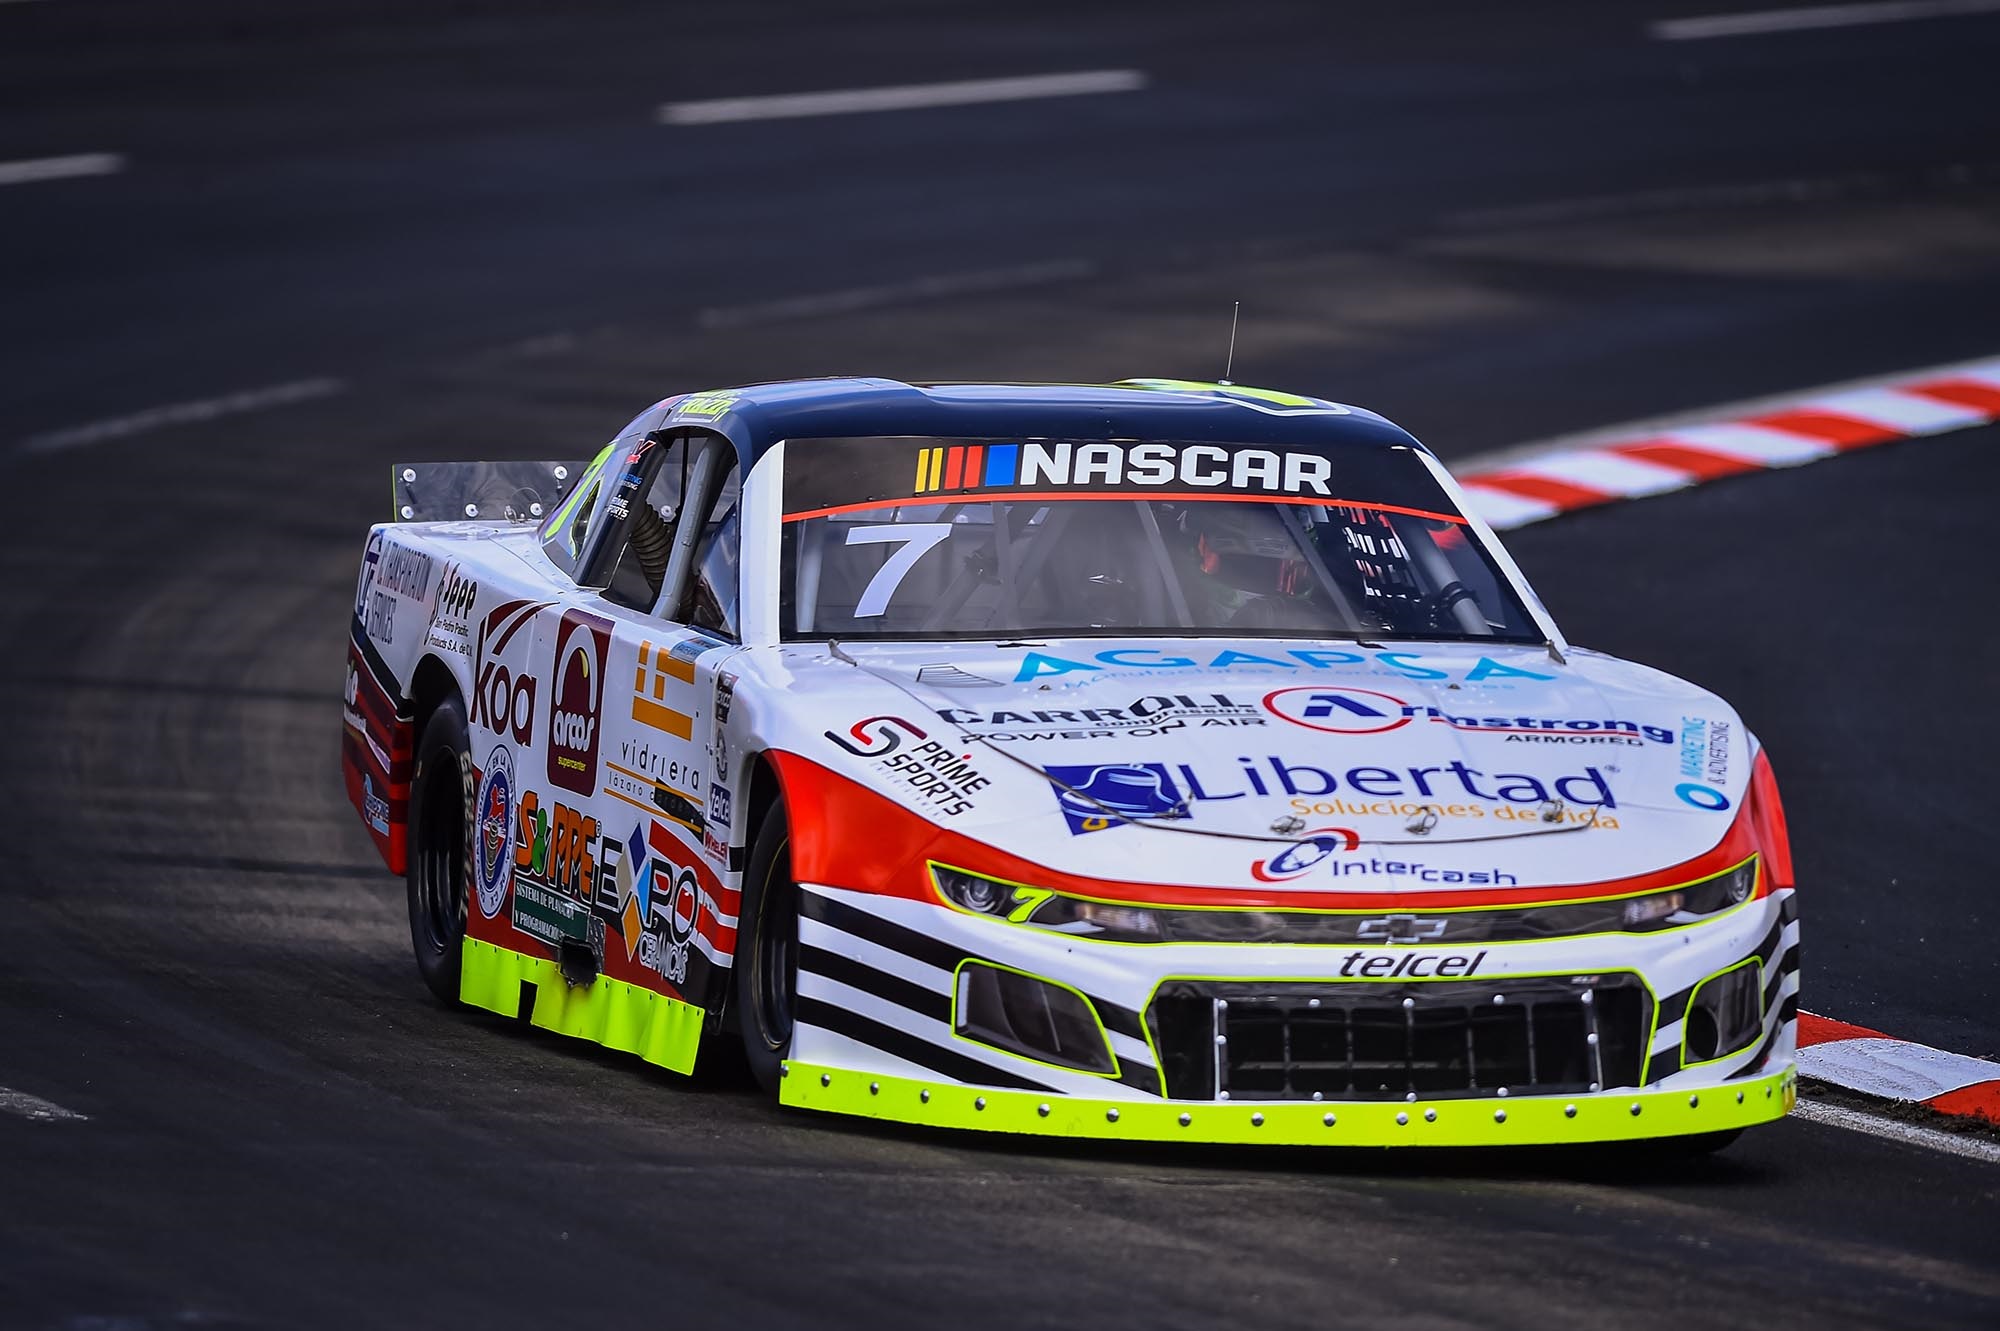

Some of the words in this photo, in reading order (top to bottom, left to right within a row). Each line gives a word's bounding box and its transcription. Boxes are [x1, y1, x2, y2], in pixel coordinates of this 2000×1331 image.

[1019, 443, 1331, 496] NASCAR
[845, 522, 953, 619] 7
[470, 614, 538, 748] koa
[1013, 648, 1557, 683] AGAPSA
[936, 694, 1254, 725] CARROLL
[1096, 708, 1259, 728] compressors
[553, 710, 595, 752] arcos
[960, 730, 1117, 745] POWER
[1127, 719, 1187, 738] ON
[1201, 717, 1268, 728] AIR
[1505, 733, 1645, 748] ARMORED
[622, 738, 700, 791] vidriera
[912, 741, 992, 796] PRIME
[882, 754, 975, 816] SPORTS
[1178, 755, 1617, 810] Libertad
[1290, 798, 1485, 818] Soluciones
[1493, 802, 1538, 822] de
[1333, 858, 1518, 887] Intercash
[516, 882, 540, 904] SISTEMA
[540, 891, 548, 908] DE
[1006, 885, 1056, 923] 7
[514, 909, 520, 923] Y
[1338, 951, 1488, 977] telcel
